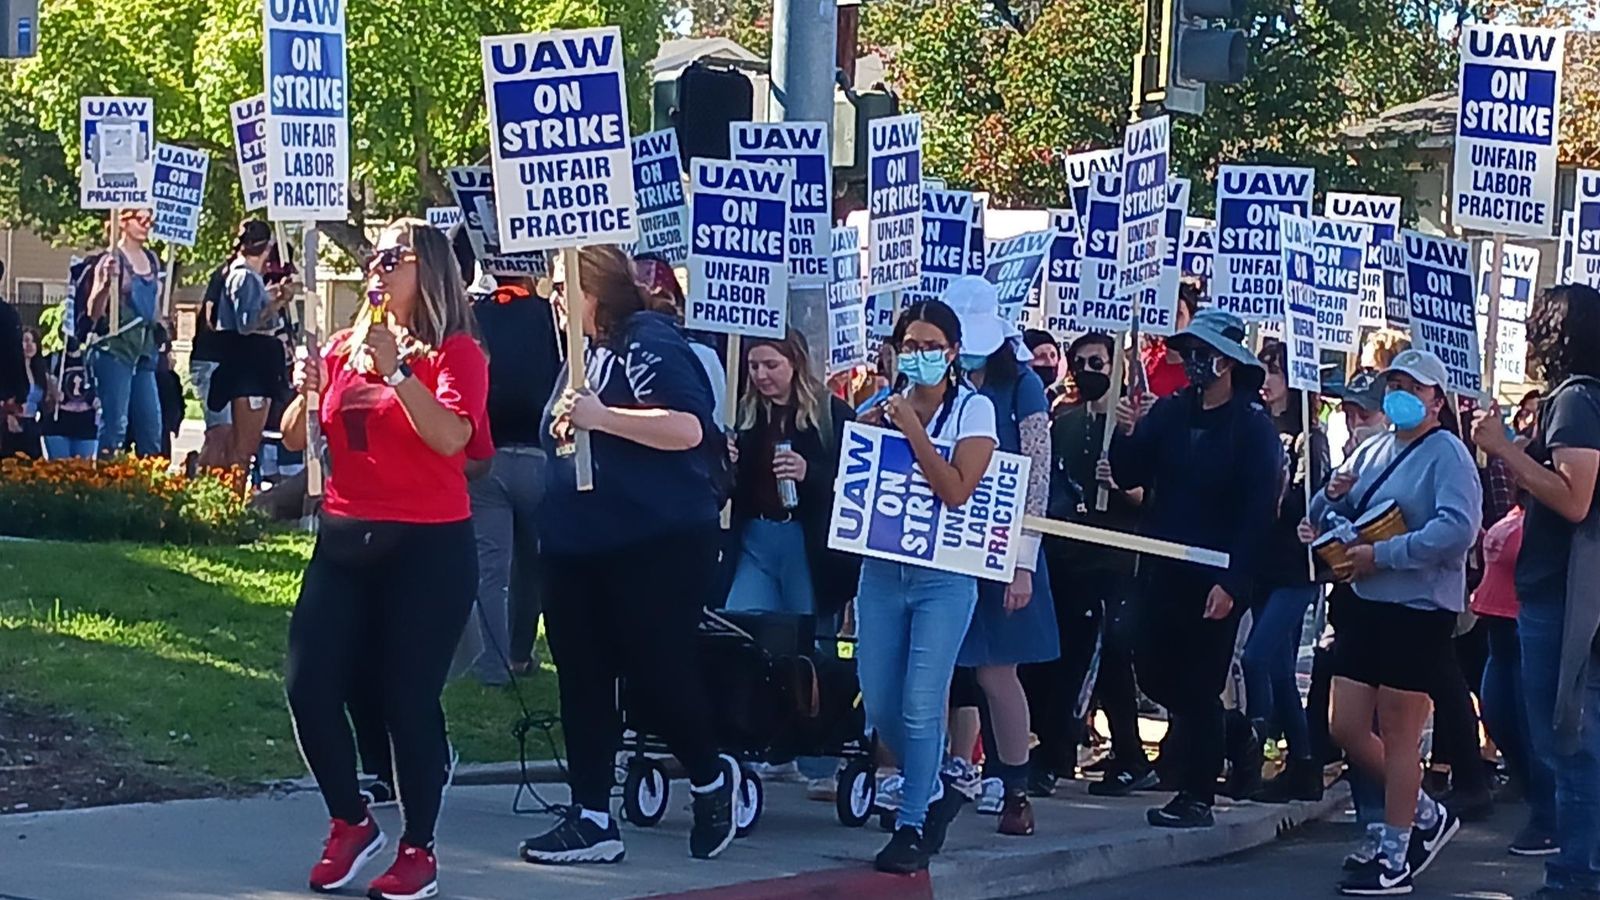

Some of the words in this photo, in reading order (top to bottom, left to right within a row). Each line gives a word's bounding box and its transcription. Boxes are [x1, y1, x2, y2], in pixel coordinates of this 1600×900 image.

[270, 0, 339, 26] UAW
[291, 37, 322, 71] ON
[491, 35, 615, 74] UAW
[1469, 29, 1556, 63] UAW
[272, 75, 343, 111] STRIKE
[533, 81, 582, 114] ON
[1491, 68, 1527, 101] ON
[88, 101, 147, 116] UAW
[236, 100, 265, 120] UA
[1463, 101, 1551, 138] STRIKE
[281, 122, 336, 148] UNFAIR
[502, 114, 621, 152] STRIKE
[739, 128, 822, 150] UAW
[872, 120, 920, 150] UAW
[1128, 121, 1167, 155] UAW
[158, 147, 205, 169] UAW
[285, 152, 334, 178] LABOR
[519, 156, 611, 185] UNFAIR
[886, 156, 906, 183] ON
[1471, 144, 1537, 172] UNFAIR
[168, 169, 190, 185] ON
[451, 171, 493, 188] UA
[641, 162, 663, 184] ON
[699, 165, 785, 194] UAW
[1137, 159, 1156, 186] ON
[1223, 172, 1309, 196] UAW
[1473, 170, 1532, 198] LABOR
[87, 190, 148, 202] PRACTICE
[154, 182, 200, 203] STRIKE
[274, 182, 344, 207] PRACTICE
[526, 183, 609, 211] LABOR
[872, 184, 919, 214] STRIKE
[922, 192, 967, 215] AW
[1124, 184, 1165, 218] STRIKE
[155, 213, 188, 227] LABOR
[156, 200, 192, 216] UNFAIR
[430, 210, 462, 224] UAW
[722, 199, 758, 225] ON
[1246, 203, 1279, 226] ON
[1333, 198, 1396, 220] UAW
[1458, 193, 1545, 225] PRACTICE
[153, 224, 193, 241] RACTICE
[509, 208, 631, 240] PRACTICE
[641, 211, 681, 233] UNFAIR
[877, 217, 914, 241] UNFAIR
[1315, 222, 1363, 243] AW
[646, 229, 682, 250] LABOR
[695, 223, 782, 256] STRIKE
[879, 239, 912, 262] LABOR
[1221, 227, 1280, 251] STRI
[483, 257, 547, 273] PRACTI
[922, 244, 961, 268] IKE
[1315, 245, 1342, 267] ON
[1383, 244, 1404, 268] UA
[1404, 235, 1468, 270] UAW
[704, 261, 770, 285] UNFAIR
[789, 258, 828, 275] TICE
[871, 258, 918, 285] PRACTICE
[1229, 257, 1281, 276] UNFAI
[1315, 268, 1358, 290] RIKE
[707, 282, 766, 305] LABOR
[1426, 271, 1453, 297] ON
[693, 302, 780, 328] PRACTICE
[1082, 300, 1169, 326] PRACICE
[1218, 295, 1286, 315] PRACTI
[1317, 294, 1348, 312] FAIR
[1412, 292, 1474, 326] STRIKE
[1317, 310, 1344, 326] BOR
[1421, 323, 1469, 350] UNFAIR
[836, 430, 874, 540] UAW
[875, 470, 908, 517] ON
[901, 461, 936, 556] STRI
[966, 475, 994, 549] LABOR
[985, 460, 1020, 571] PRACTICE
